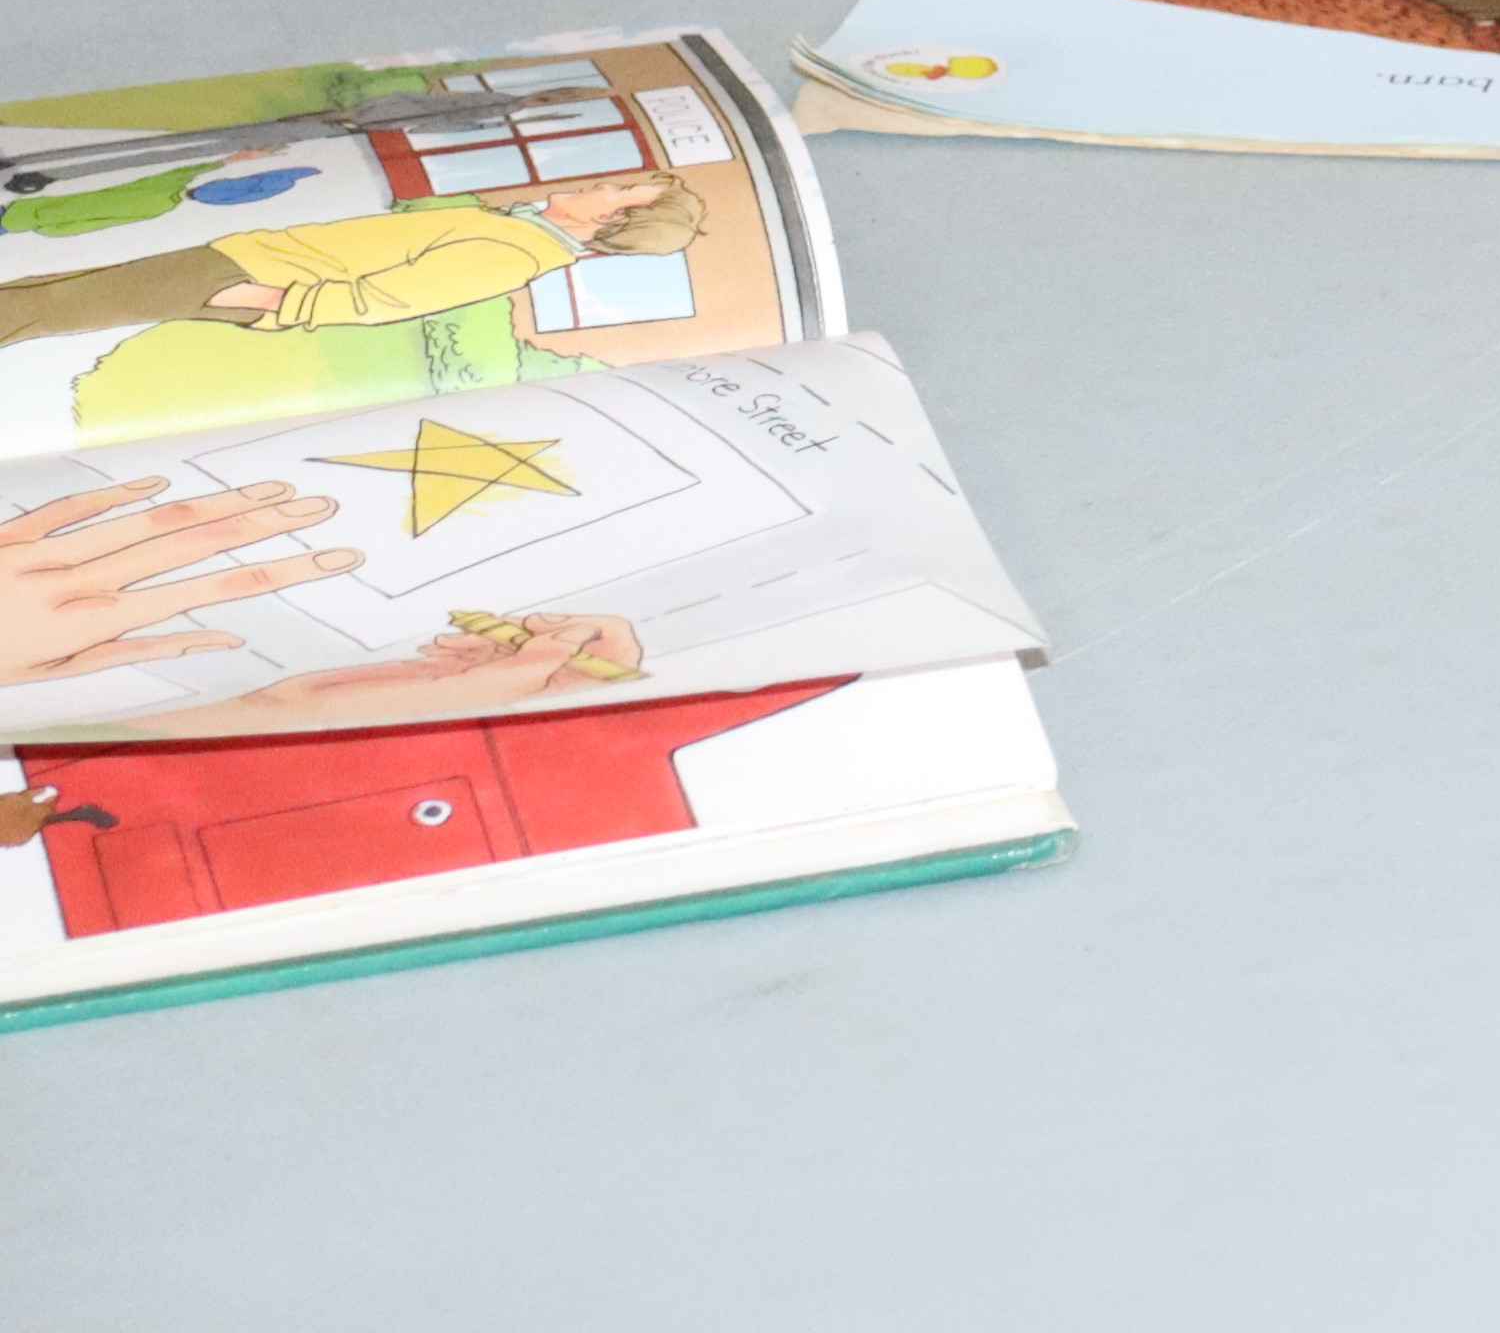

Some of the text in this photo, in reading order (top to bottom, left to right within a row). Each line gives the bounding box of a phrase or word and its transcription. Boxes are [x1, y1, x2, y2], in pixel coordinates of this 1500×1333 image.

[1377, 71, 1493, 94] barn.
[640, 92, 713, 153] POLICE
[738, 392, 840, 454] Street
